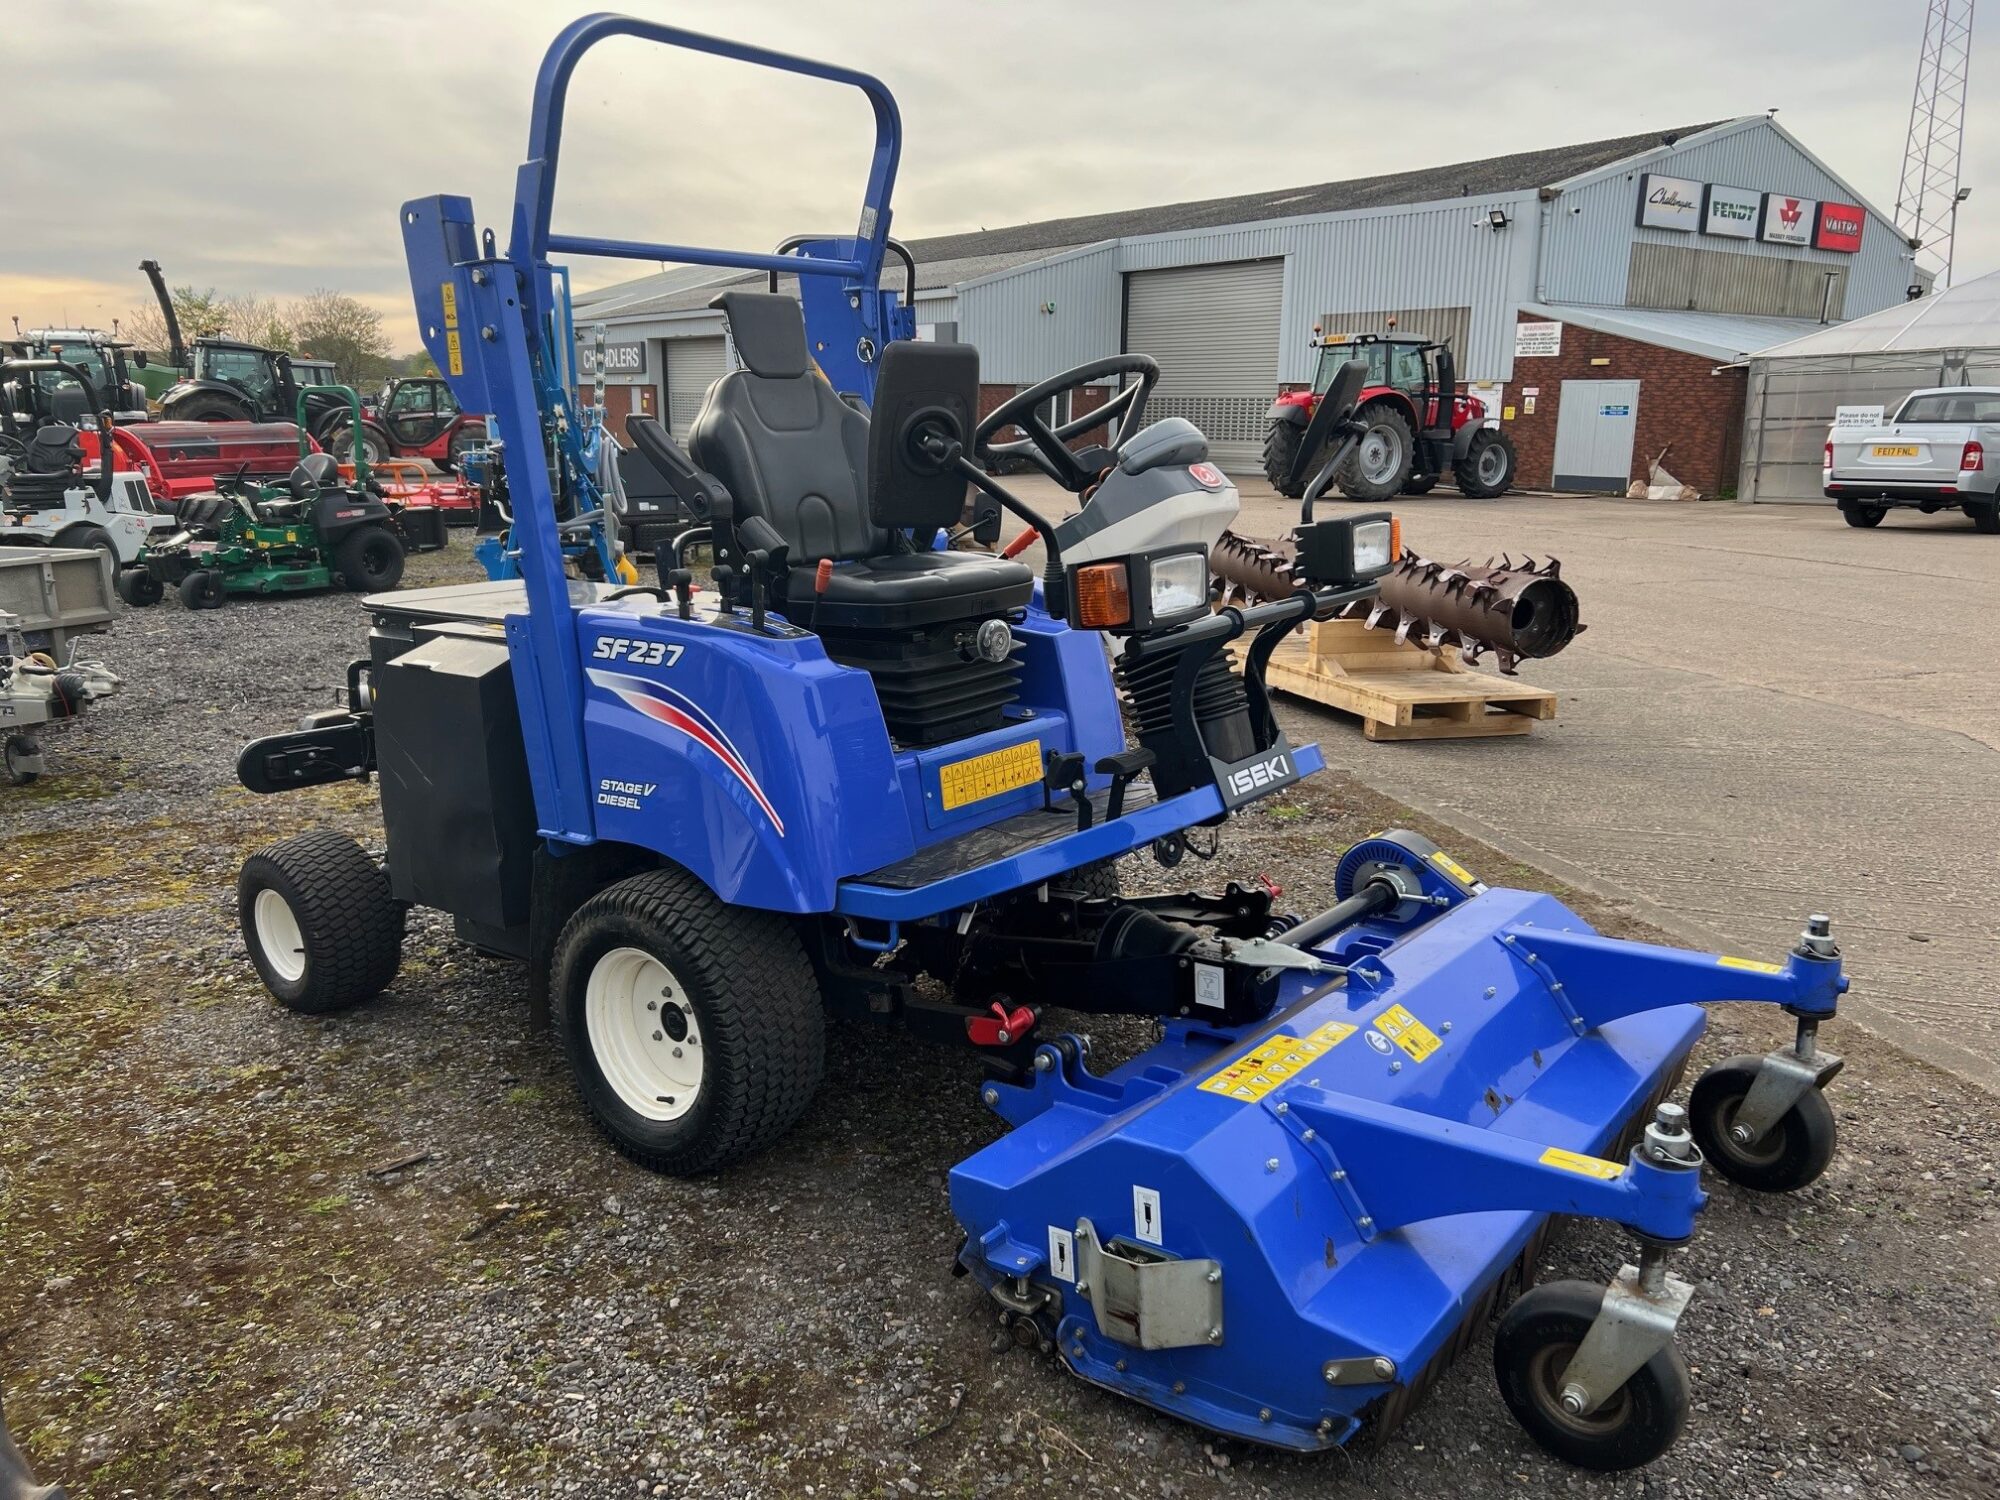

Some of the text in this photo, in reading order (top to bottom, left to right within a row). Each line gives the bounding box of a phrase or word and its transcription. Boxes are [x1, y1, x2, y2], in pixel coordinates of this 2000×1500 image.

[1649, 187, 1697, 213] Challenger
[1712, 200, 1756, 221] FENDT
[1825, 216, 1858, 236] VALTRA
[583, 347, 640, 369] CHNDLERS
[1877, 447, 1912, 456] FE17 FNL
[1227, 754, 1290, 797] ISEKI
[600, 779, 657, 797] STAGE V
[597, 793, 641, 810] DIESEL
